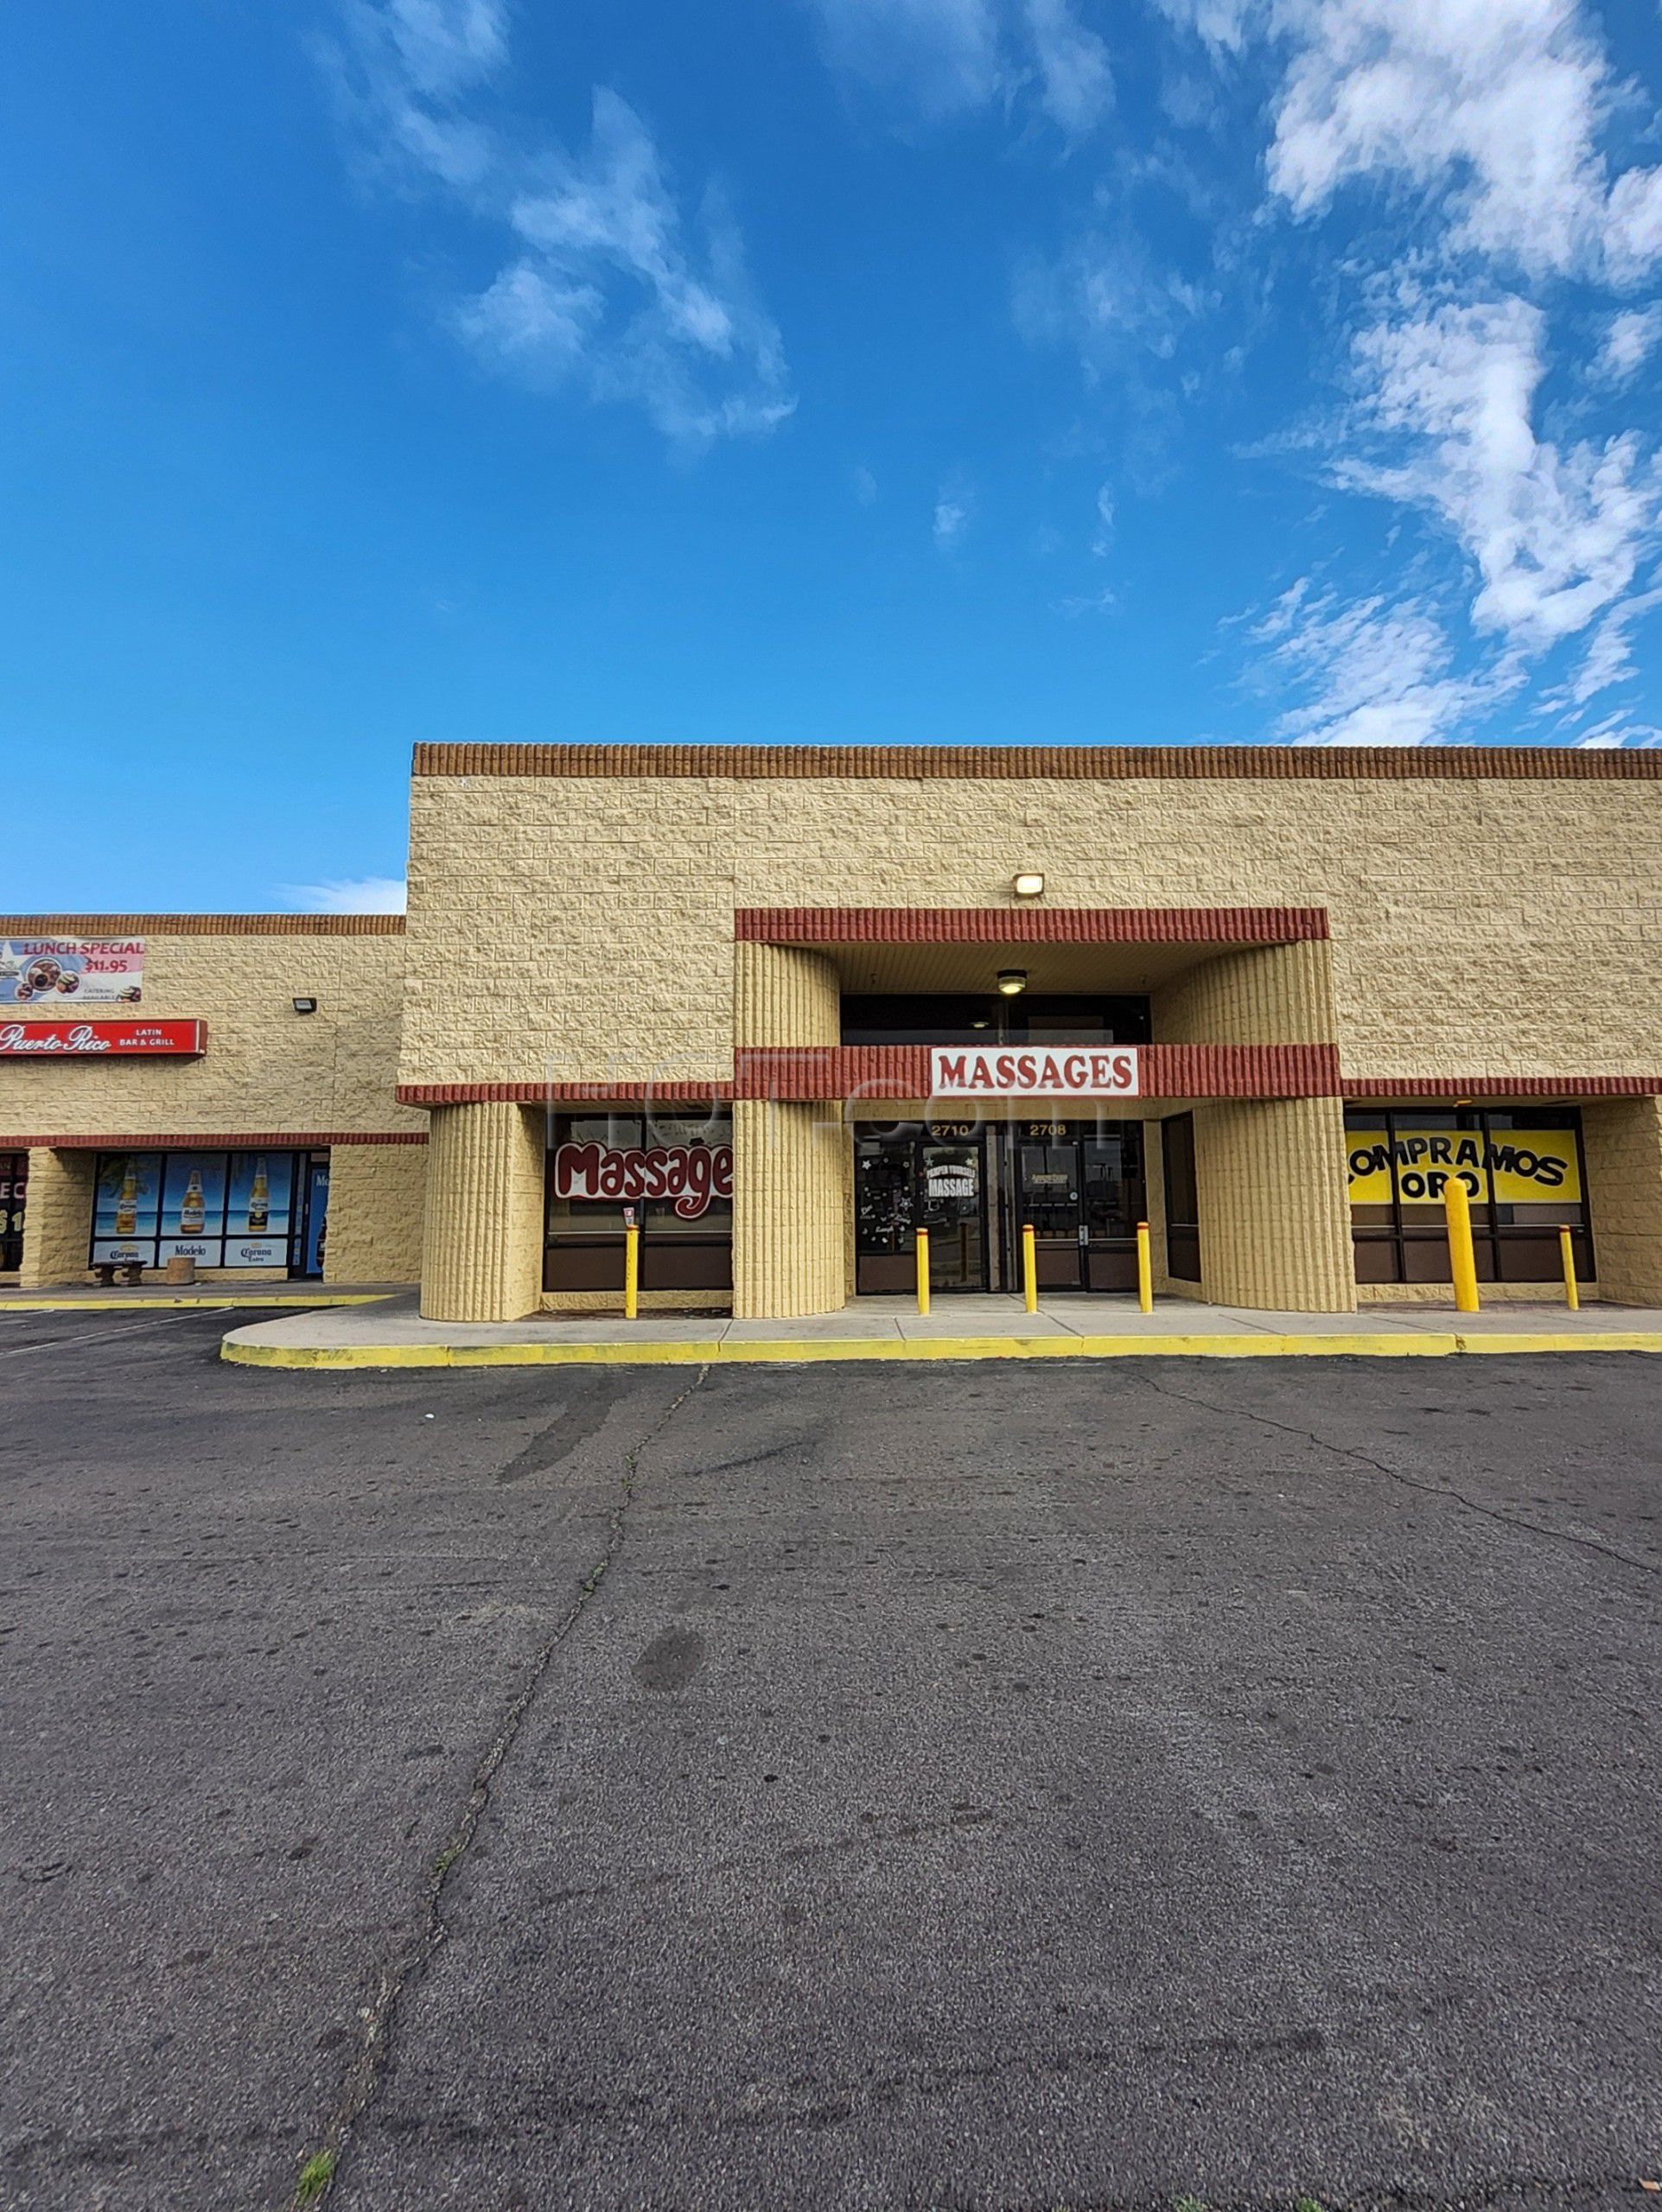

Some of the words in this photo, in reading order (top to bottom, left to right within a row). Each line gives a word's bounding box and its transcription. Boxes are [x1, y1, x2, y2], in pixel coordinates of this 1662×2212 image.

[23, 942, 76, 955] LUNCH
[80, 942, 144, 955] SPECIAL
[86, 958, 127, 973] $11.95
[0, 1024, 61, 1051] Puerto
[63, 1026, 111, 1052] Rico
[939, 1054, 1132, 1089] MASSAGES
[932, 1125, 969, 1136] 2710
[1030, 1124, 1067, 1135] 2708
[1348, 1137, 1568, 1186] OMPRAMOS
[928, 1178, 974, 1198] MASSAGE
[110, 1250, 139, 1260] Corona
[175, 1244, 207, 1256] Modelo
[240, 1248, 272, 1258] Corona
